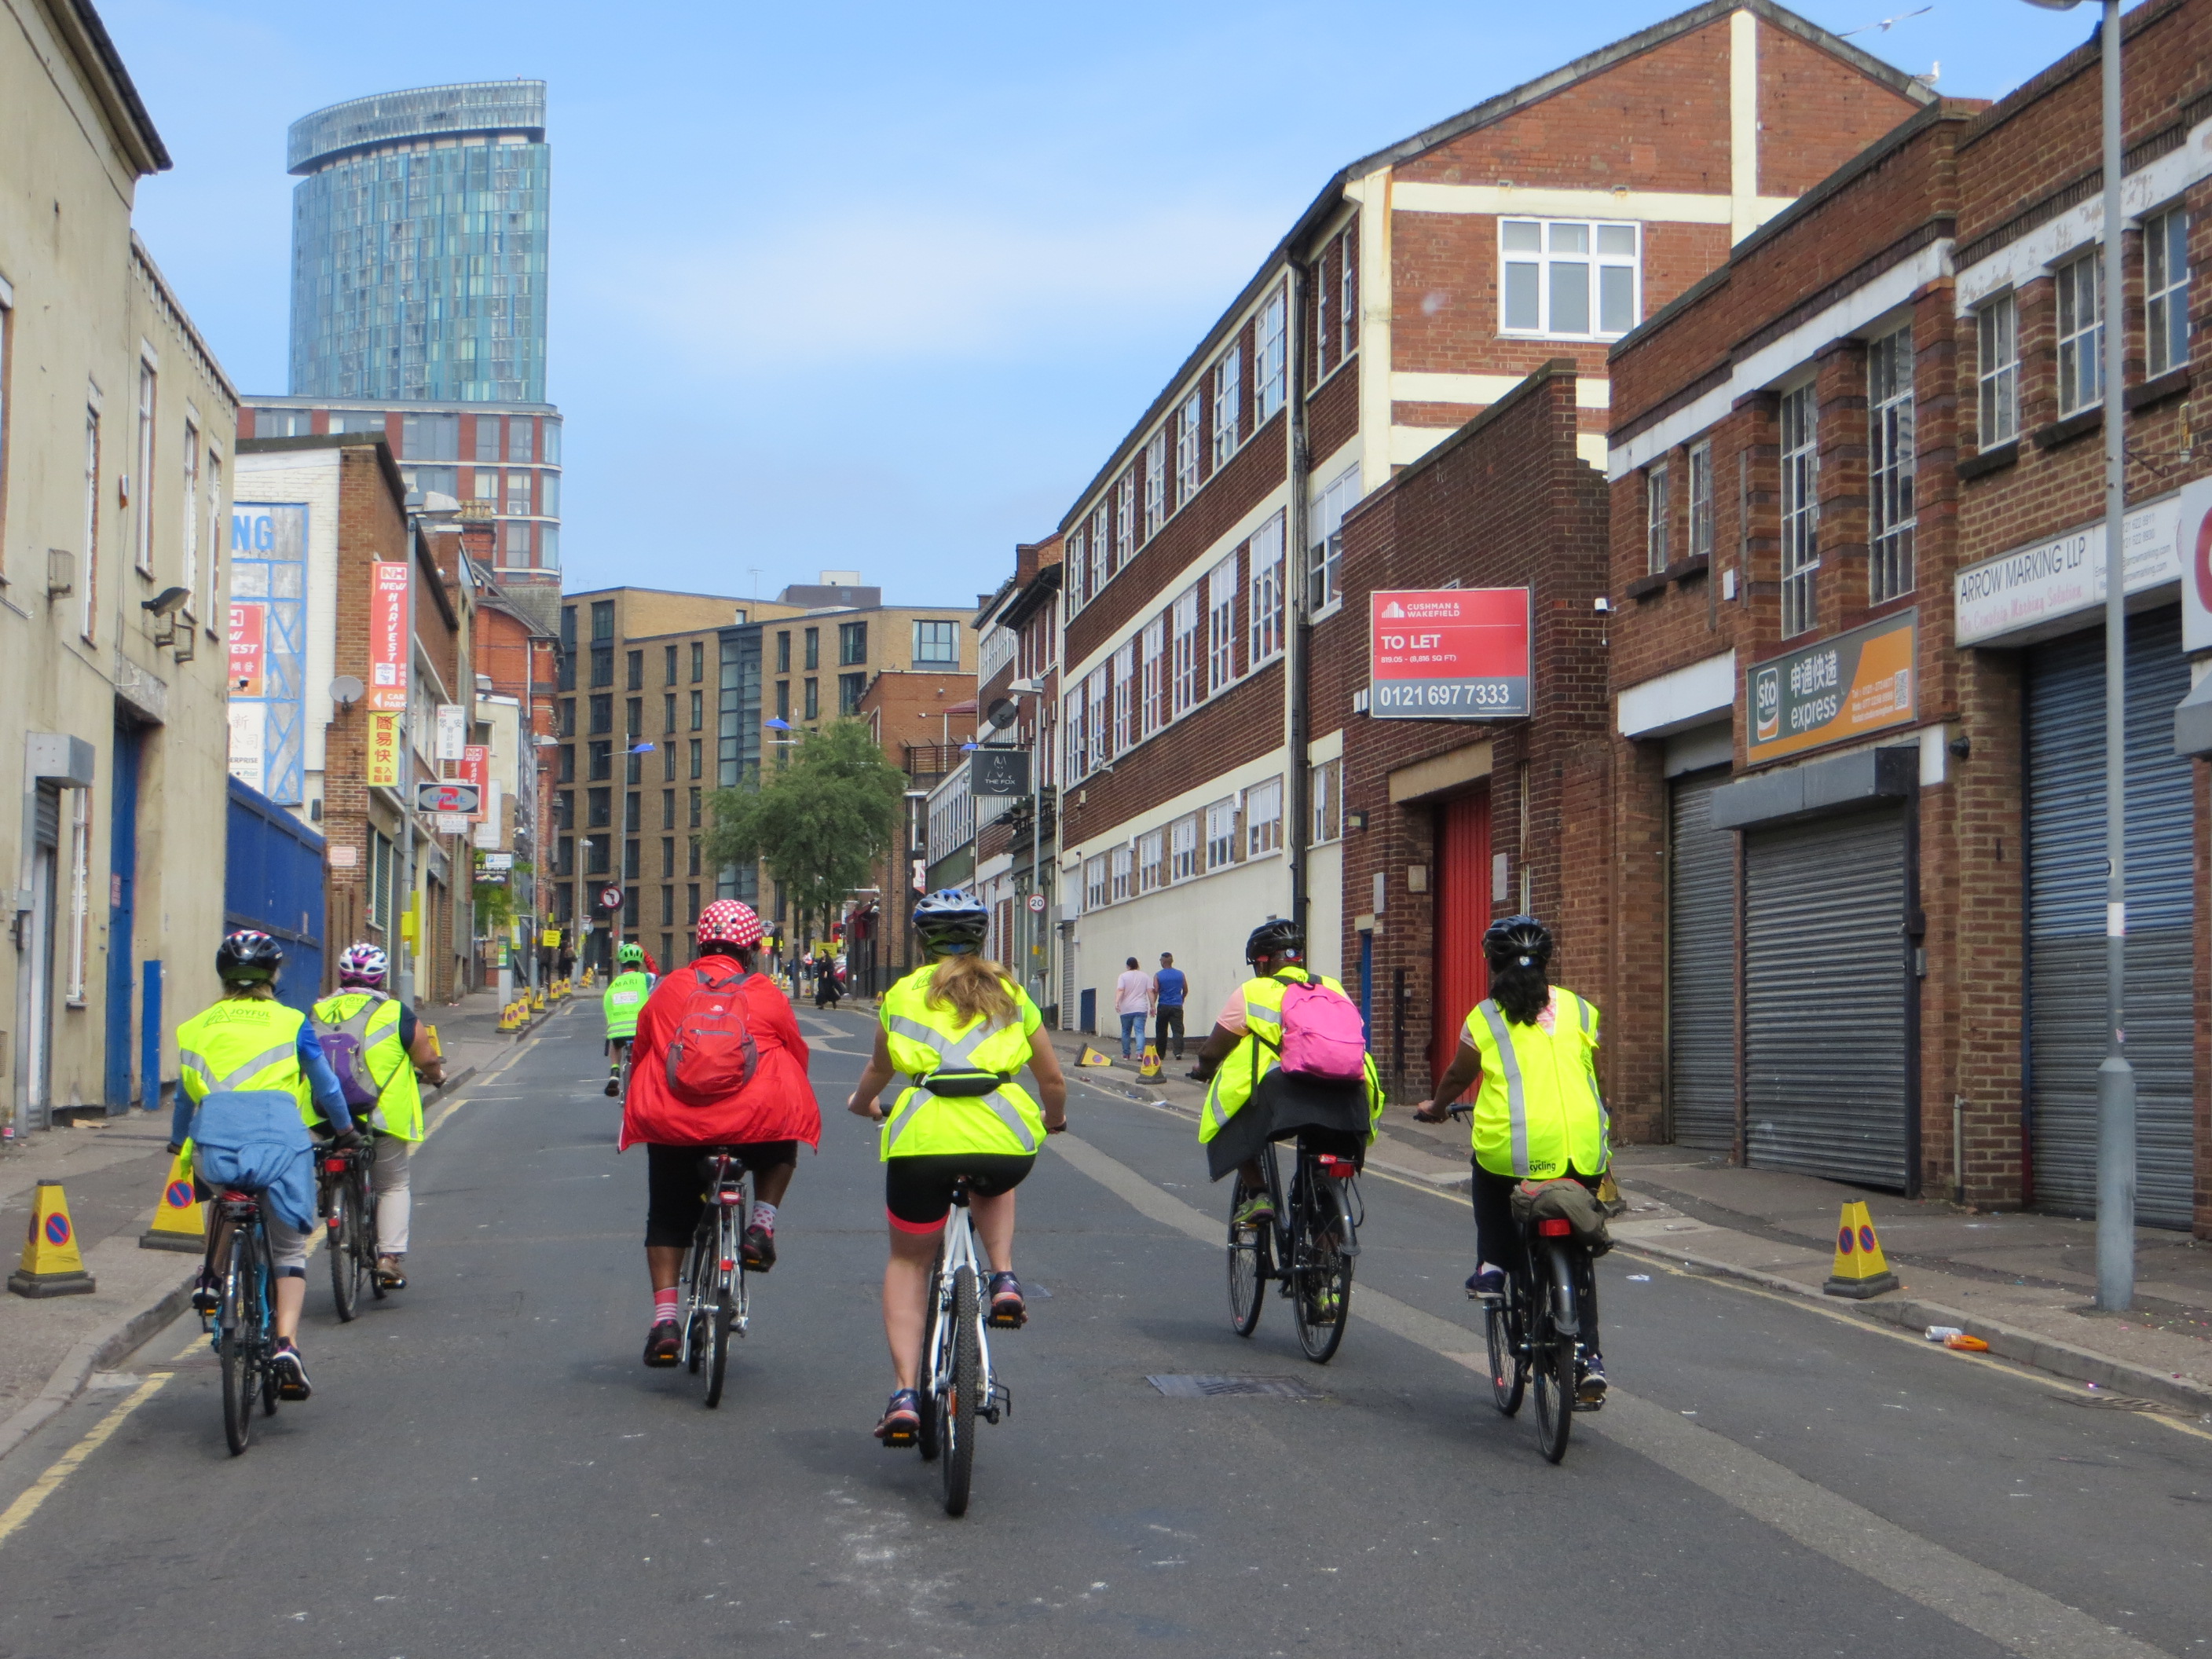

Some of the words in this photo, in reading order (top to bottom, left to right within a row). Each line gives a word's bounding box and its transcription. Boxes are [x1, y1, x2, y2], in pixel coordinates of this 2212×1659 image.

[1960, 563, 2003, 605] ARROW
[2005, 544, 2063, 589] MARKING
[2066, 536, 2086, 569] LLP
[379, 582, 407, 591] NEW
[387, 592, 399, 662] HARVEST
[229, 644, 258, 654] EST
[1380, 635, 1404, 650] TO
[1410, 634, 1441, 649] LET
[1790, 650, 1837, 698] 申通快递
[1380, 685, 1423, 707] 0121
[1427, 684, 1461, 705] 697
[1464, 683, 1510, 705] 7333
[1759, 679, 1777, 709] sto
[1791, 694, 1837, 731] express
[438, 786, 460, 811] 2
[1031, 899, 1044, 907] 20
[230, 1008, 271, 1018] JOYFUL
[1529, 1161, 1556, 1173] cycling
